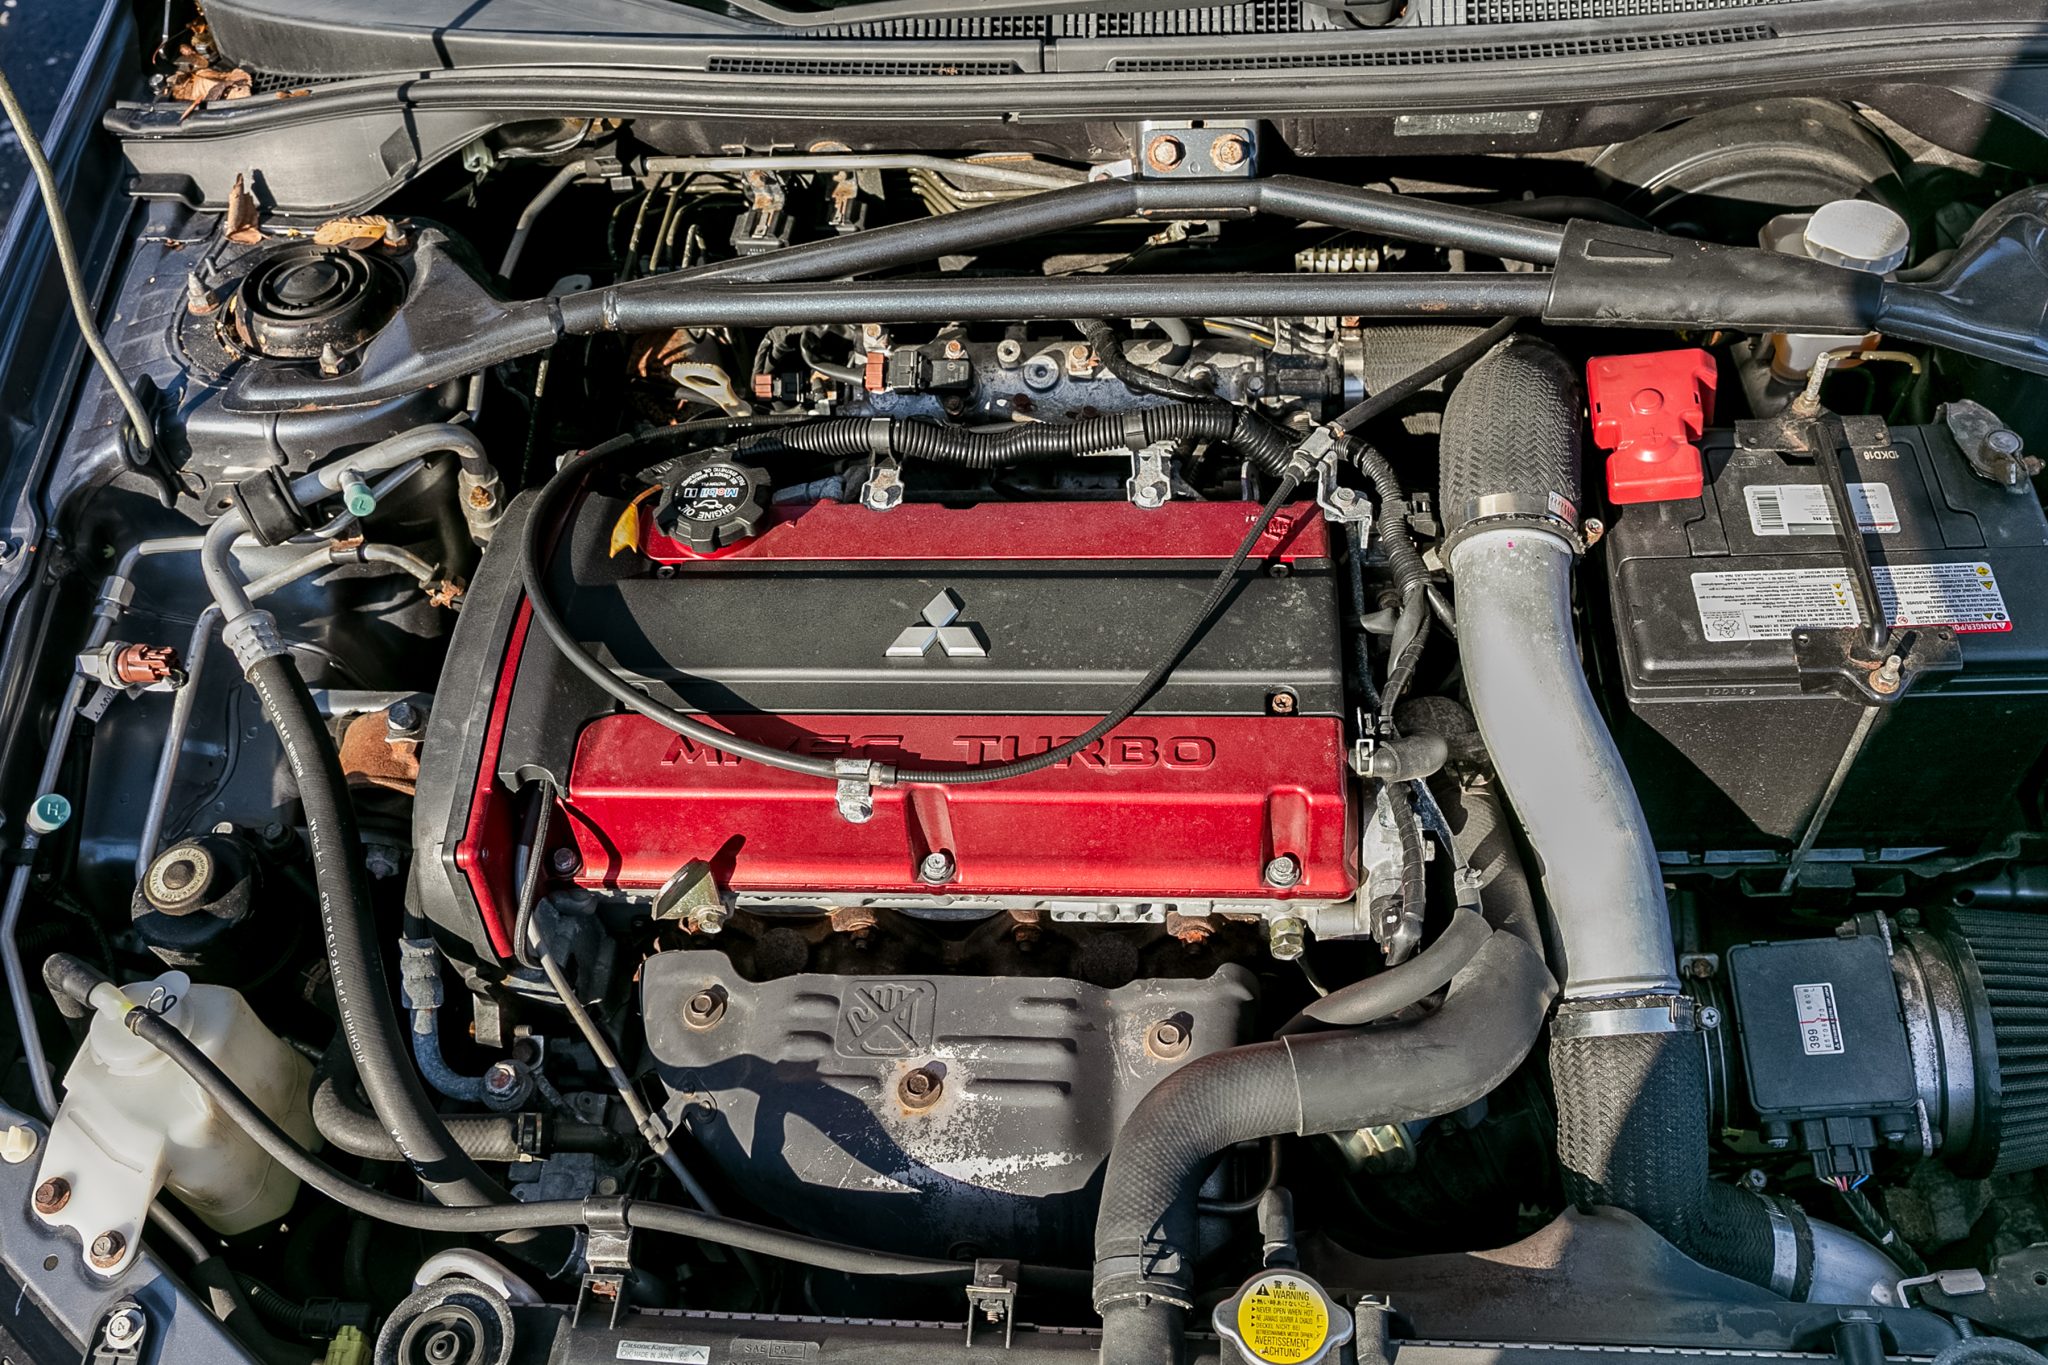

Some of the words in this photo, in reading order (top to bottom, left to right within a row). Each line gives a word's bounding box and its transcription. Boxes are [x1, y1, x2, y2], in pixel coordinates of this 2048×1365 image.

[700, 487, 739, 498] Mobil
[680, 504, 695, 517] OIL
[697, 503, 736, 519] ENGINE
[1951, 623, 1998, 631] DANGER/POI
[279, 722, 290, 741] JPN
[287, 741, 304, 778] NICHIRIN
[953, 735, 1218, 771] TURBO
[47, 803, 59, 816] H
[336, 979, 348, 1004] JPN
[344, 1009, 366, 1064] NICHIRIN
[1807, 1028, 1820, 1049] 399
[1273, 1289, 1310, 1301] WARNING
[1256, 1306, 1272, 1314] NEVER
[1254, 1335, 1309, 1348] AVERTISSEMENT
[634, 1350, 649, 1358] MADE
[744, 1343, 766, 1354] SAE
[1264, 1346, 1301, 1358] ACHTUNG
